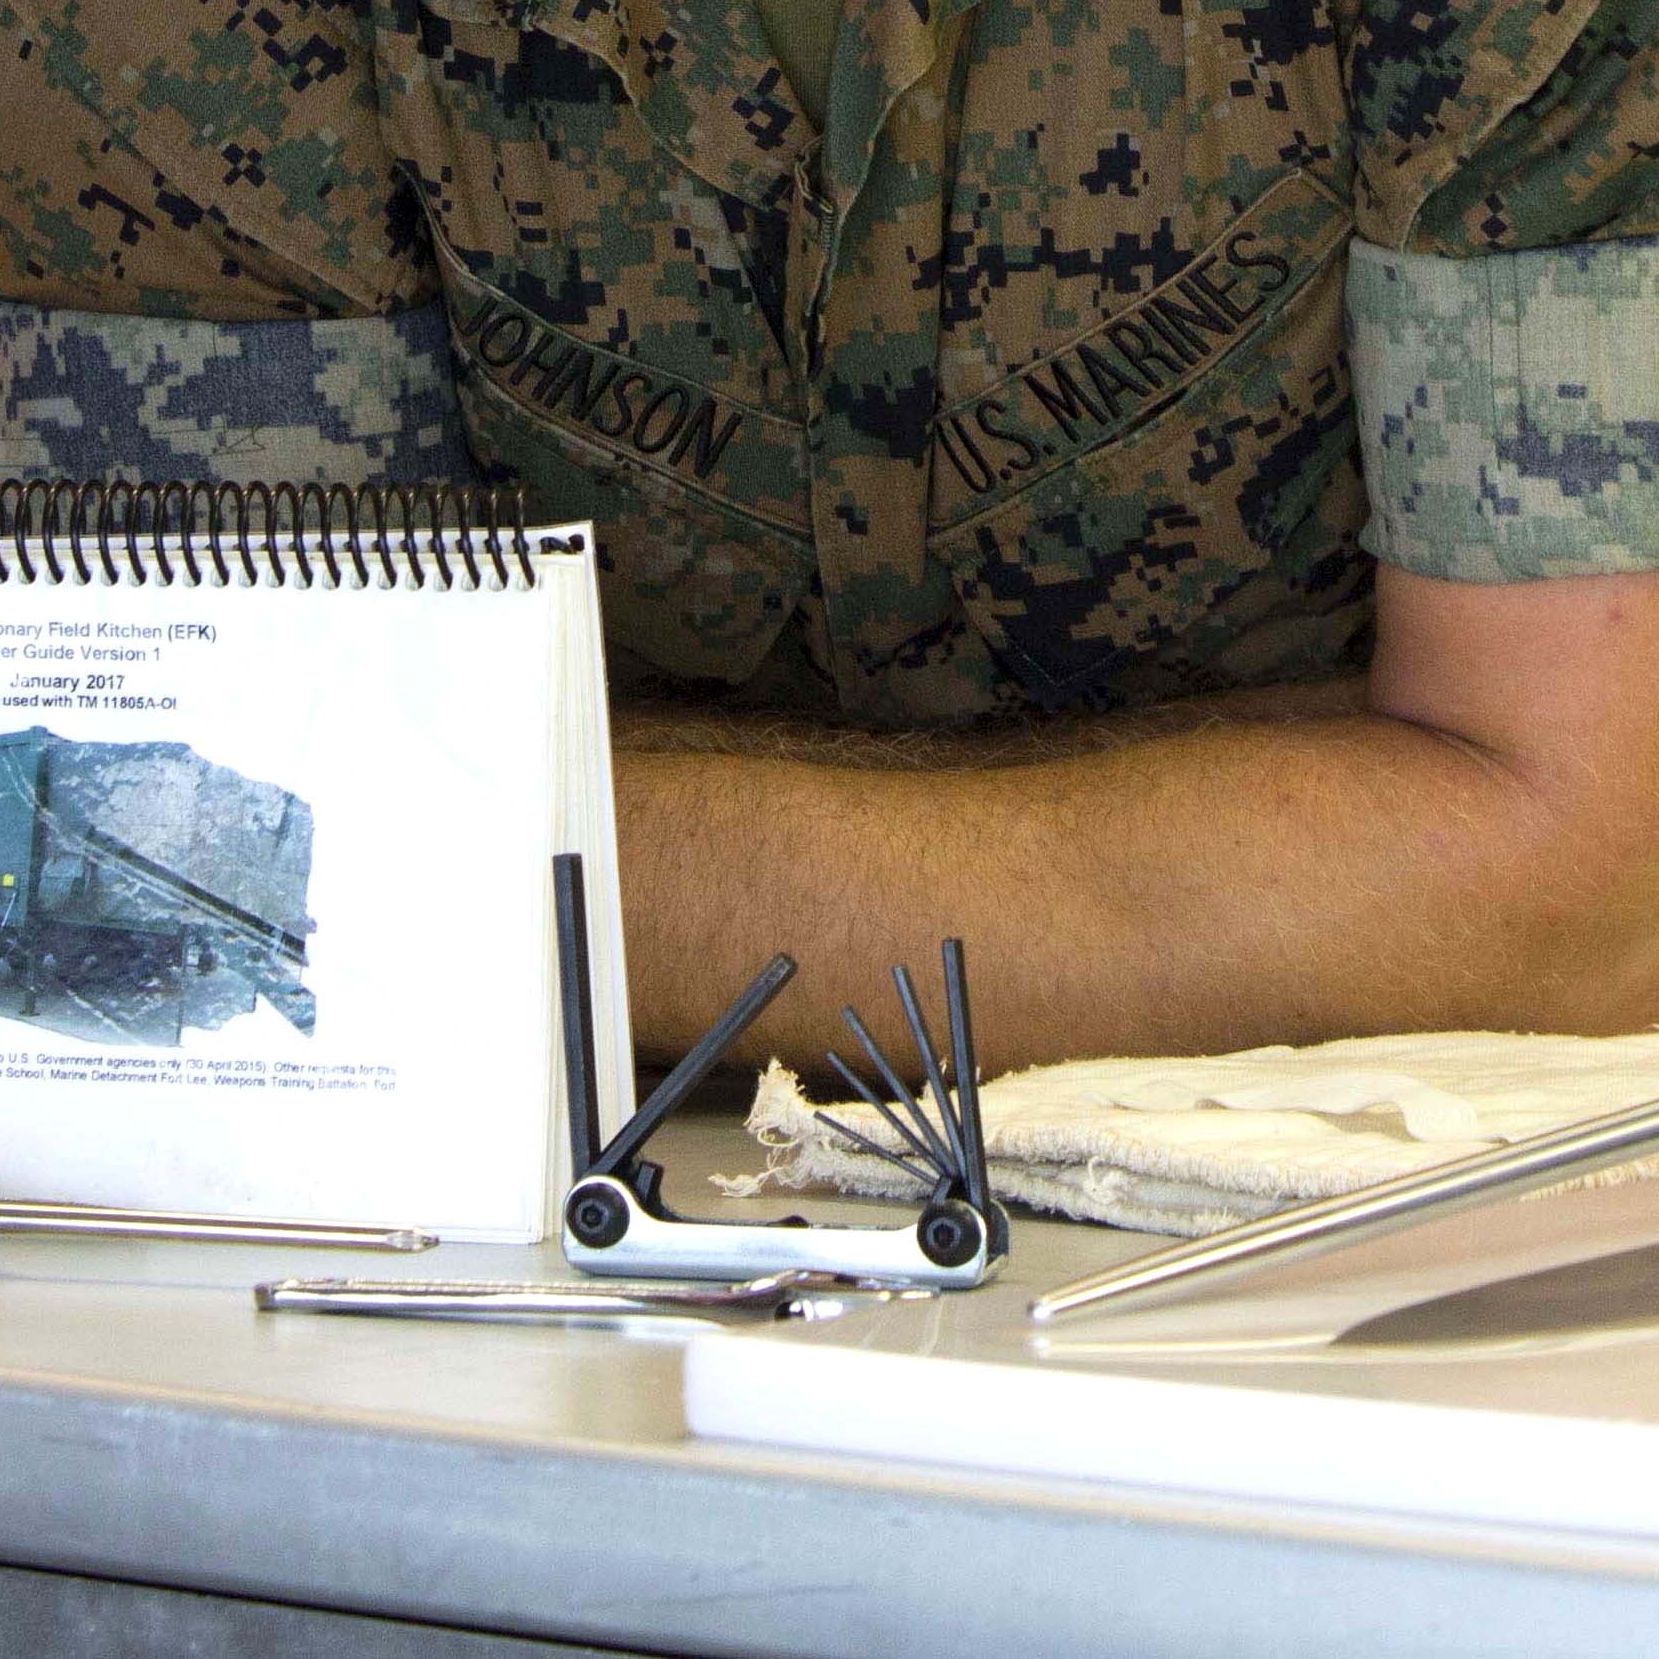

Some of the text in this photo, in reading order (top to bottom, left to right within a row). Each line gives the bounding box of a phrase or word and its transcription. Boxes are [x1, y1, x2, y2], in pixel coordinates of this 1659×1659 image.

[453, 297, 743, 479] JOHNSON
[49, 622, 90, 637] Field
[97, 622, 162, 639] Kitchen
[168, 624, 216, 644] (EFK)
[23, 643, 74, 660] Guide
[81, 645, 146, 661] Version
[153, 647, 160, 661] 1
[10, 672, 125, 693] January 2017
[3, 695, 39, 707] used
[41, 695, 73, 707] with
[77, 695, 98, 708] TM
[37, 1053, 103, 1066] Government
[106, 1058, 156, 1069] agencies
[159, 1058, 182, 1072] only
[207, 1060, 231, 1072] April
[274, 1061, 304, 1073] Other
[359, 1064, 375, 1076] for
[50, 1069, 87, 1080] Marine
[91, 1070, 157, 1083] Detachment
[161, 1072, 182, 1084] Fort
[214, 1075, 266, 1089] Weapons
[272, 1076, 314, 1091] Training
